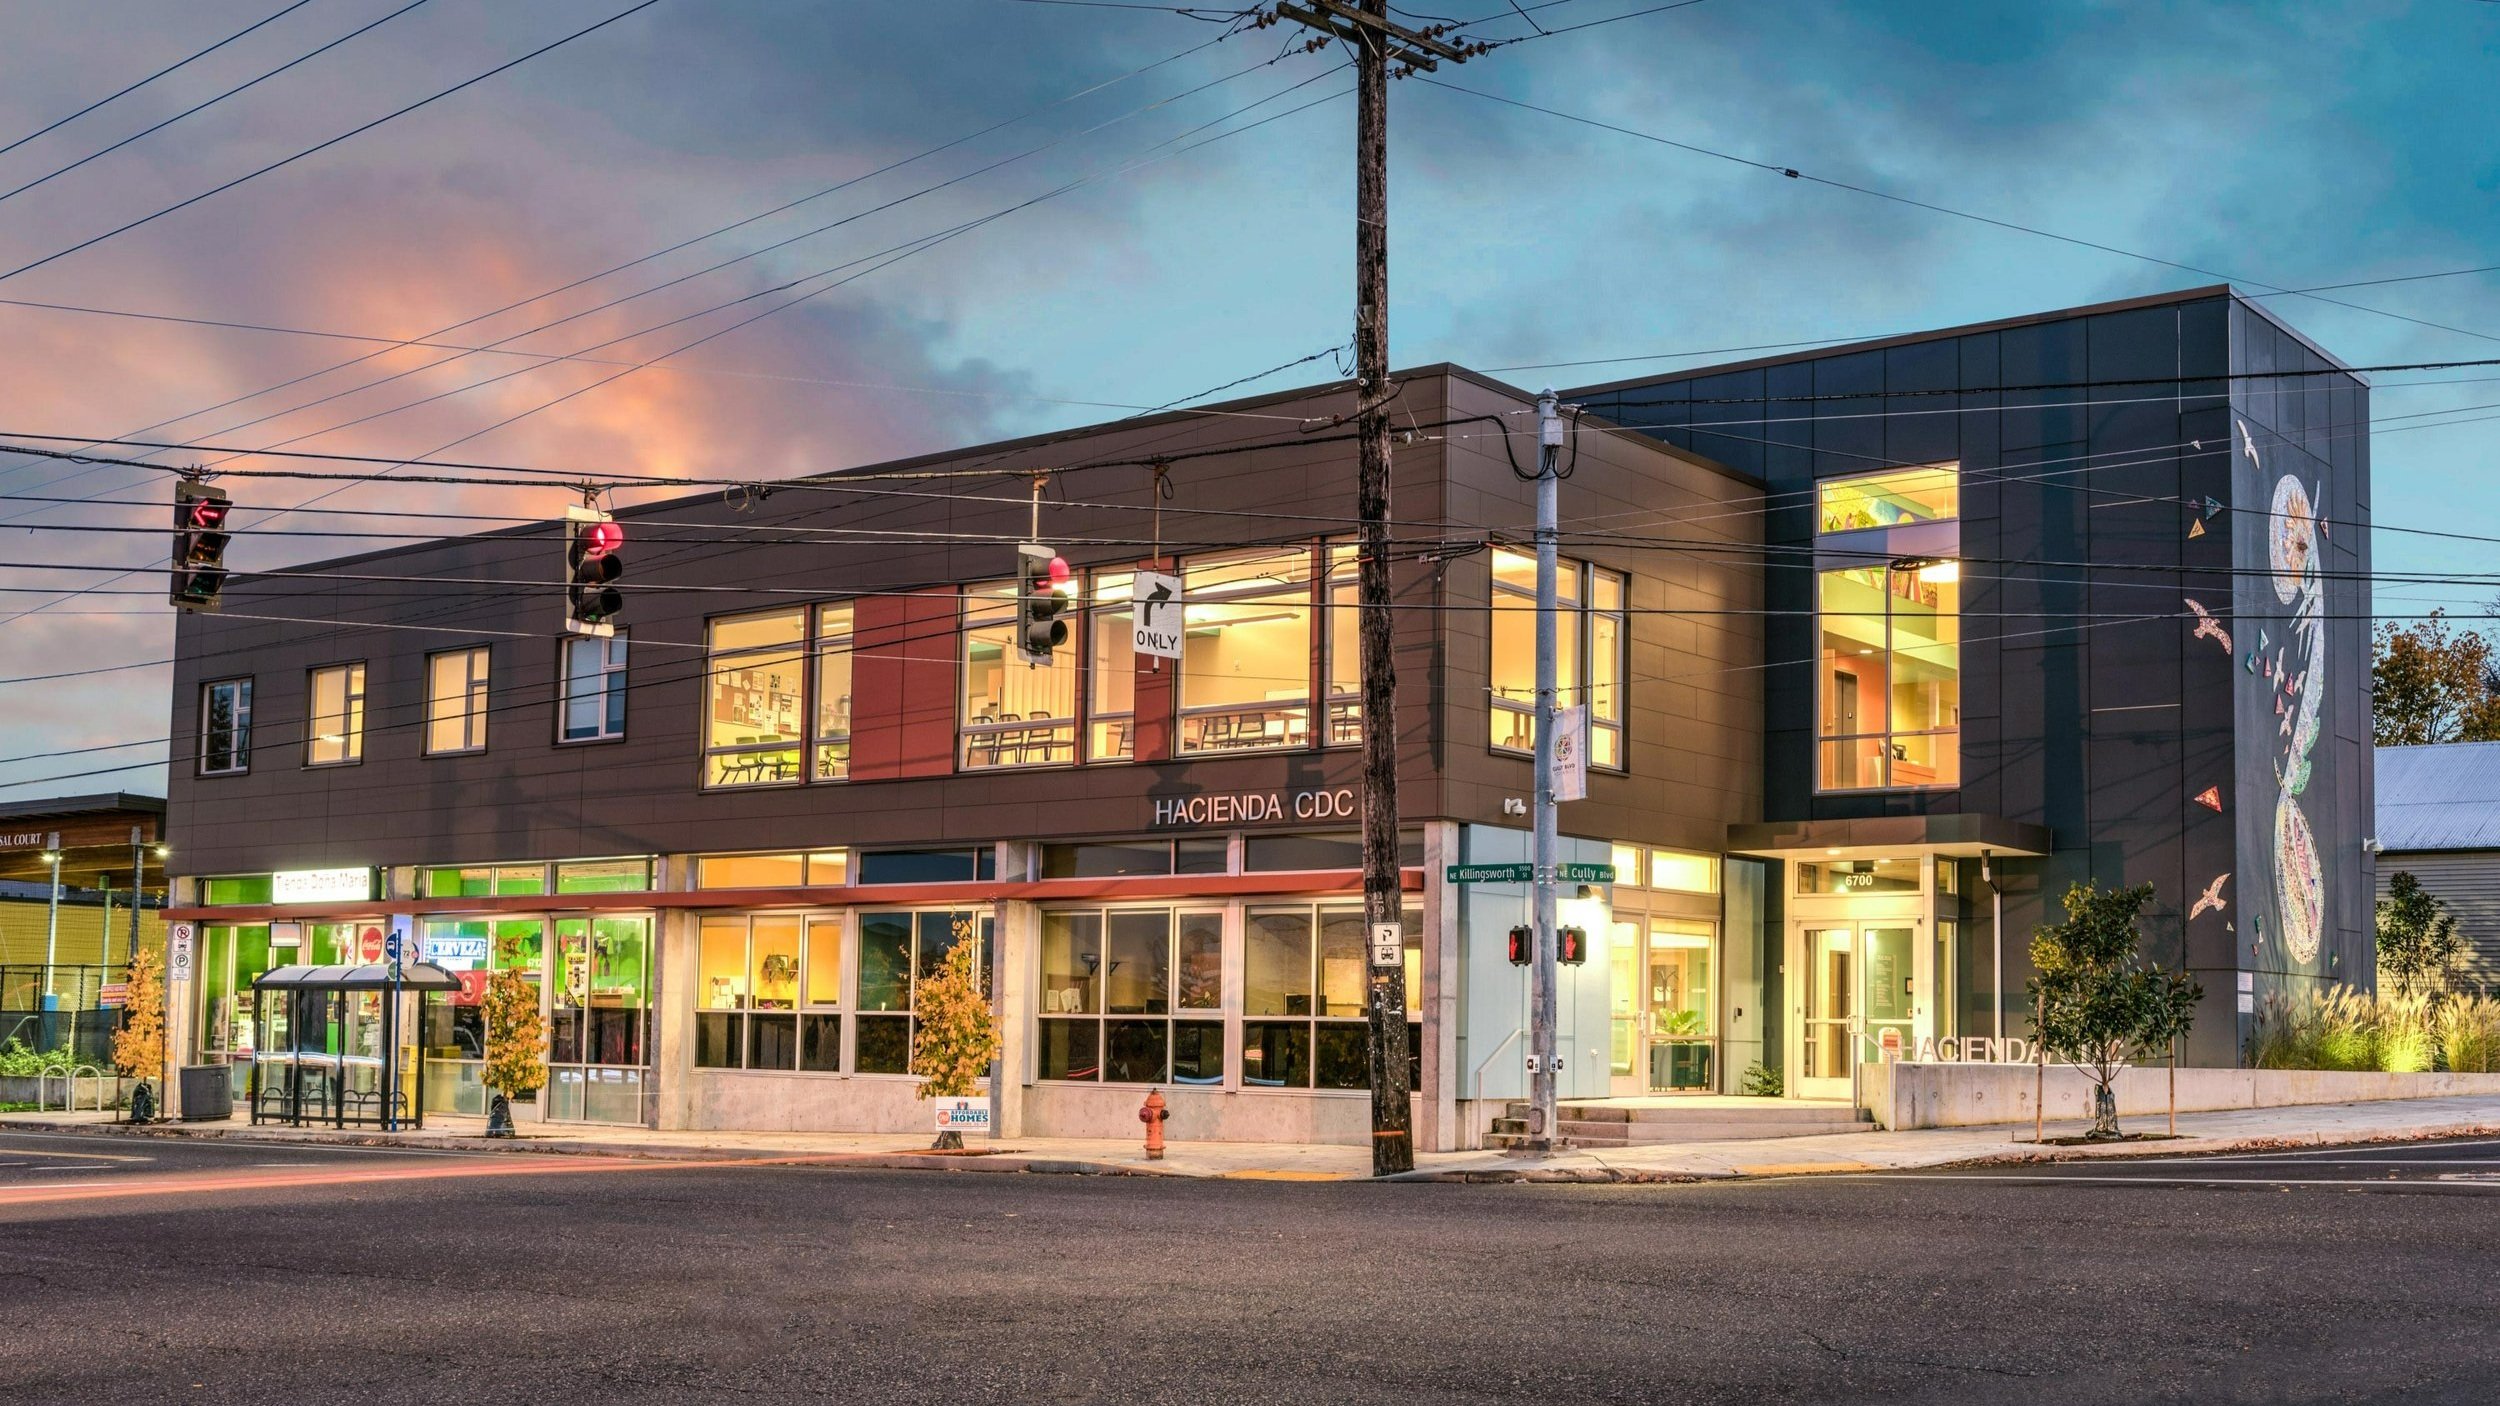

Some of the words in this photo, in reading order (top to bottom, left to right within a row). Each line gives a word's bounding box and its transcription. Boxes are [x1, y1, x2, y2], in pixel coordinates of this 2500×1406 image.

[1136, 630, 1177, 650] ONLY
[1155, 793, 1284, 824] HACIENDA
[1295, 789, 1354, 818] CDC
[14, 833, 42, 845] COURT
[1449, 872, 1457, 880] NE
[1460, 867, 1515, 881] Killingsworth
[1560, 870, 1568, 878] NE
[1571, 867, 1596, 881] Cully
[1600, 871, 1614, 879] Blvd
[1845, 874, 1873, 886] 6700
